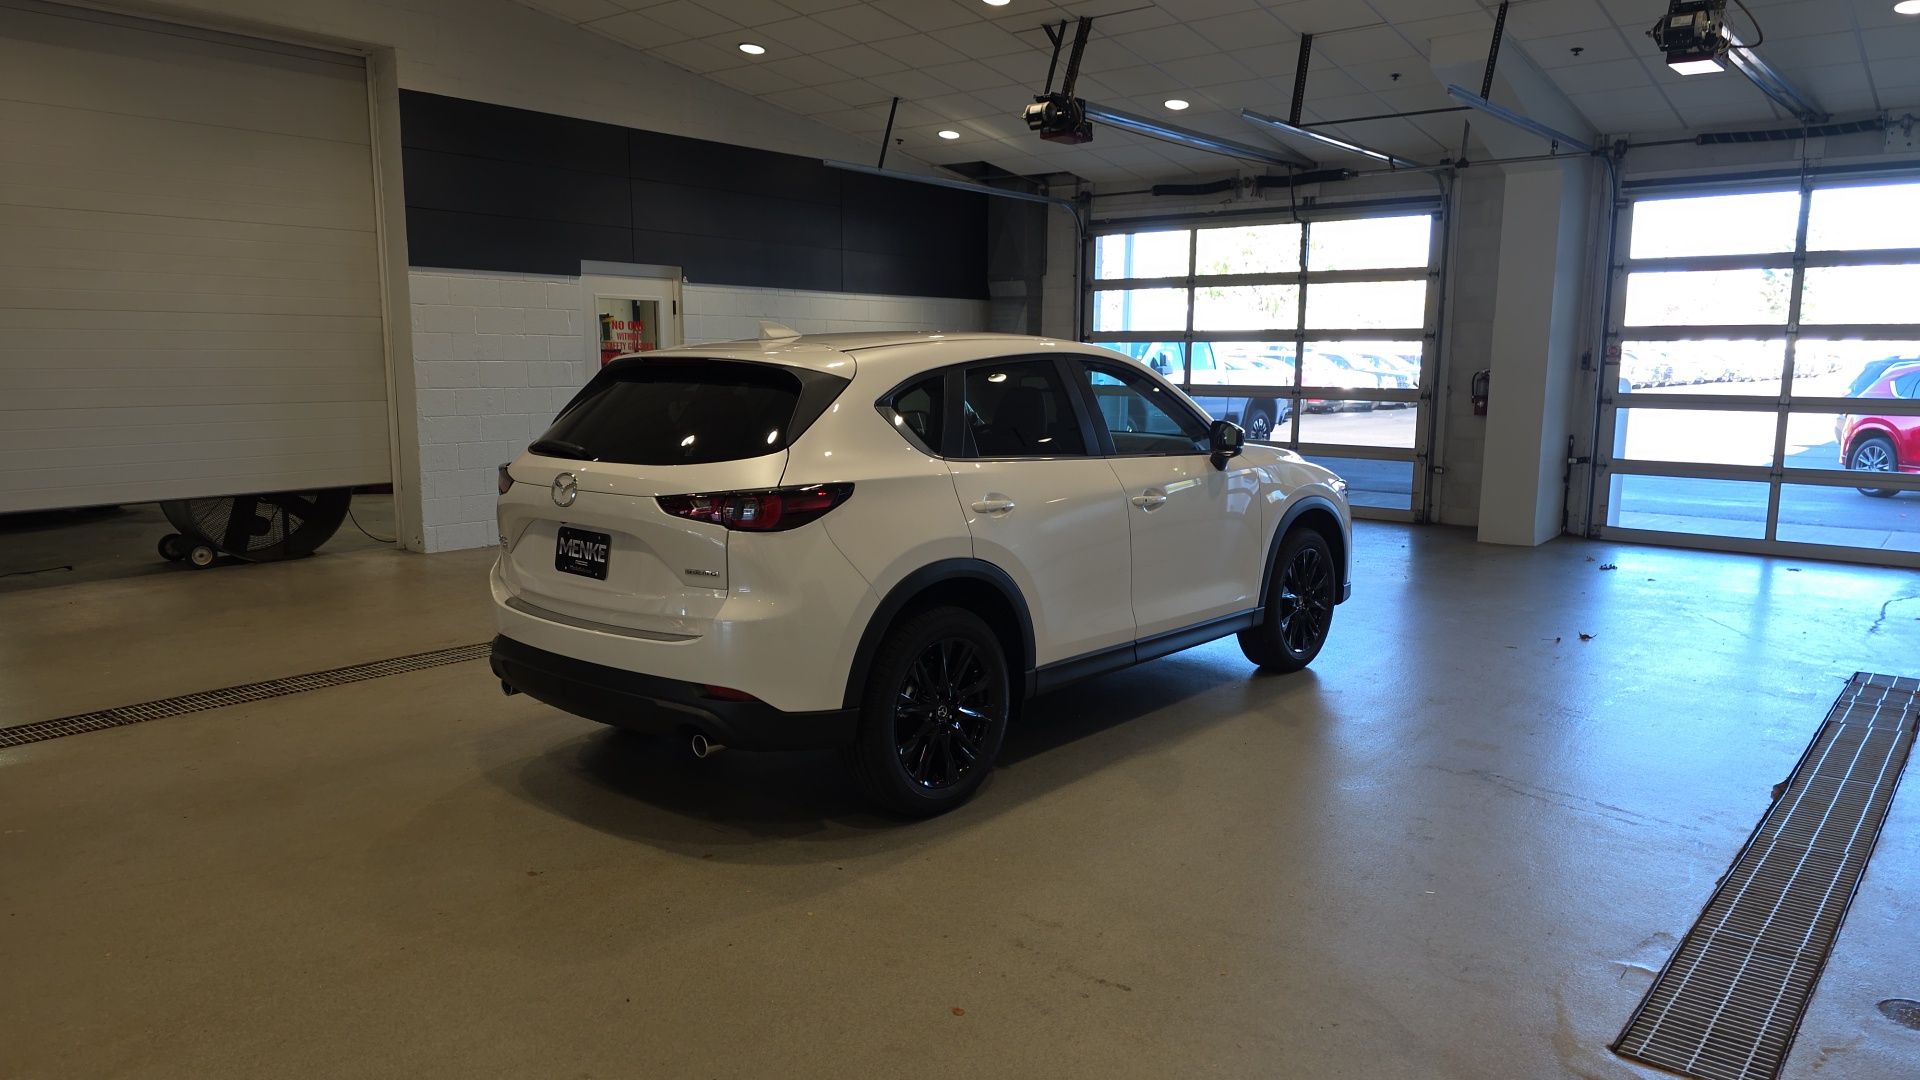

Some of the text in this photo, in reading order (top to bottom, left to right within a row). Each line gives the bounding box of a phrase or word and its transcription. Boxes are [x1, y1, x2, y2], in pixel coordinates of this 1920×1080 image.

[612, 320, 646, 331] NO ONE
[604, 342, 626, 350] SAFETY
[558, 537, 607, 563] MENKE
